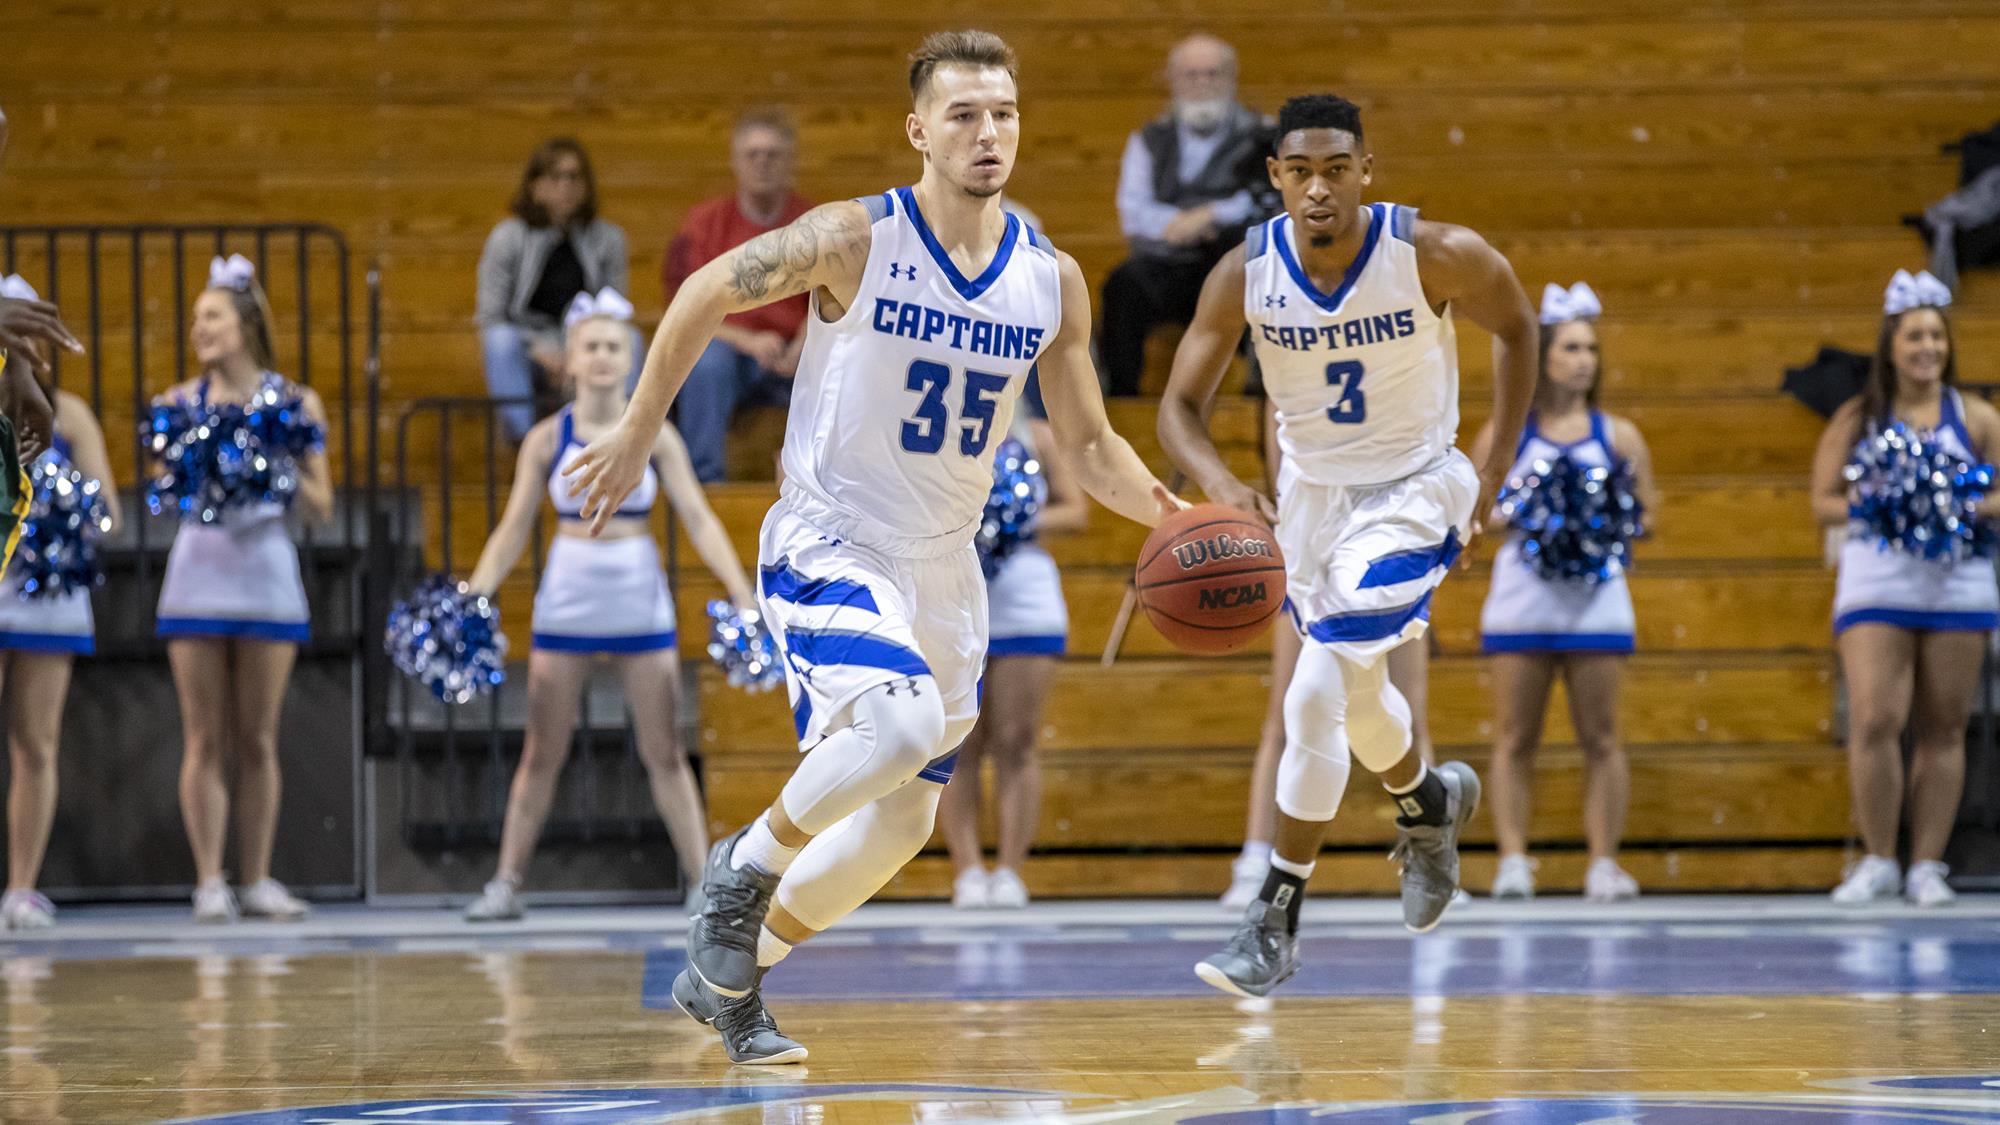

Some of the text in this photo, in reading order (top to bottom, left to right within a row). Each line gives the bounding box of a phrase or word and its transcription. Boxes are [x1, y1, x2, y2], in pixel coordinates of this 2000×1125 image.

[872, 297, 1045, 360] CAPTAINS
[1260, 308, 1416, 351] CAPTAINS
[899, 357, 1012, 457] 35
[1324, 358, 1367, 424] 3
[1172, 533, 1274, 571] Wilson
[1199, 581, 1267, 610] NCAA
